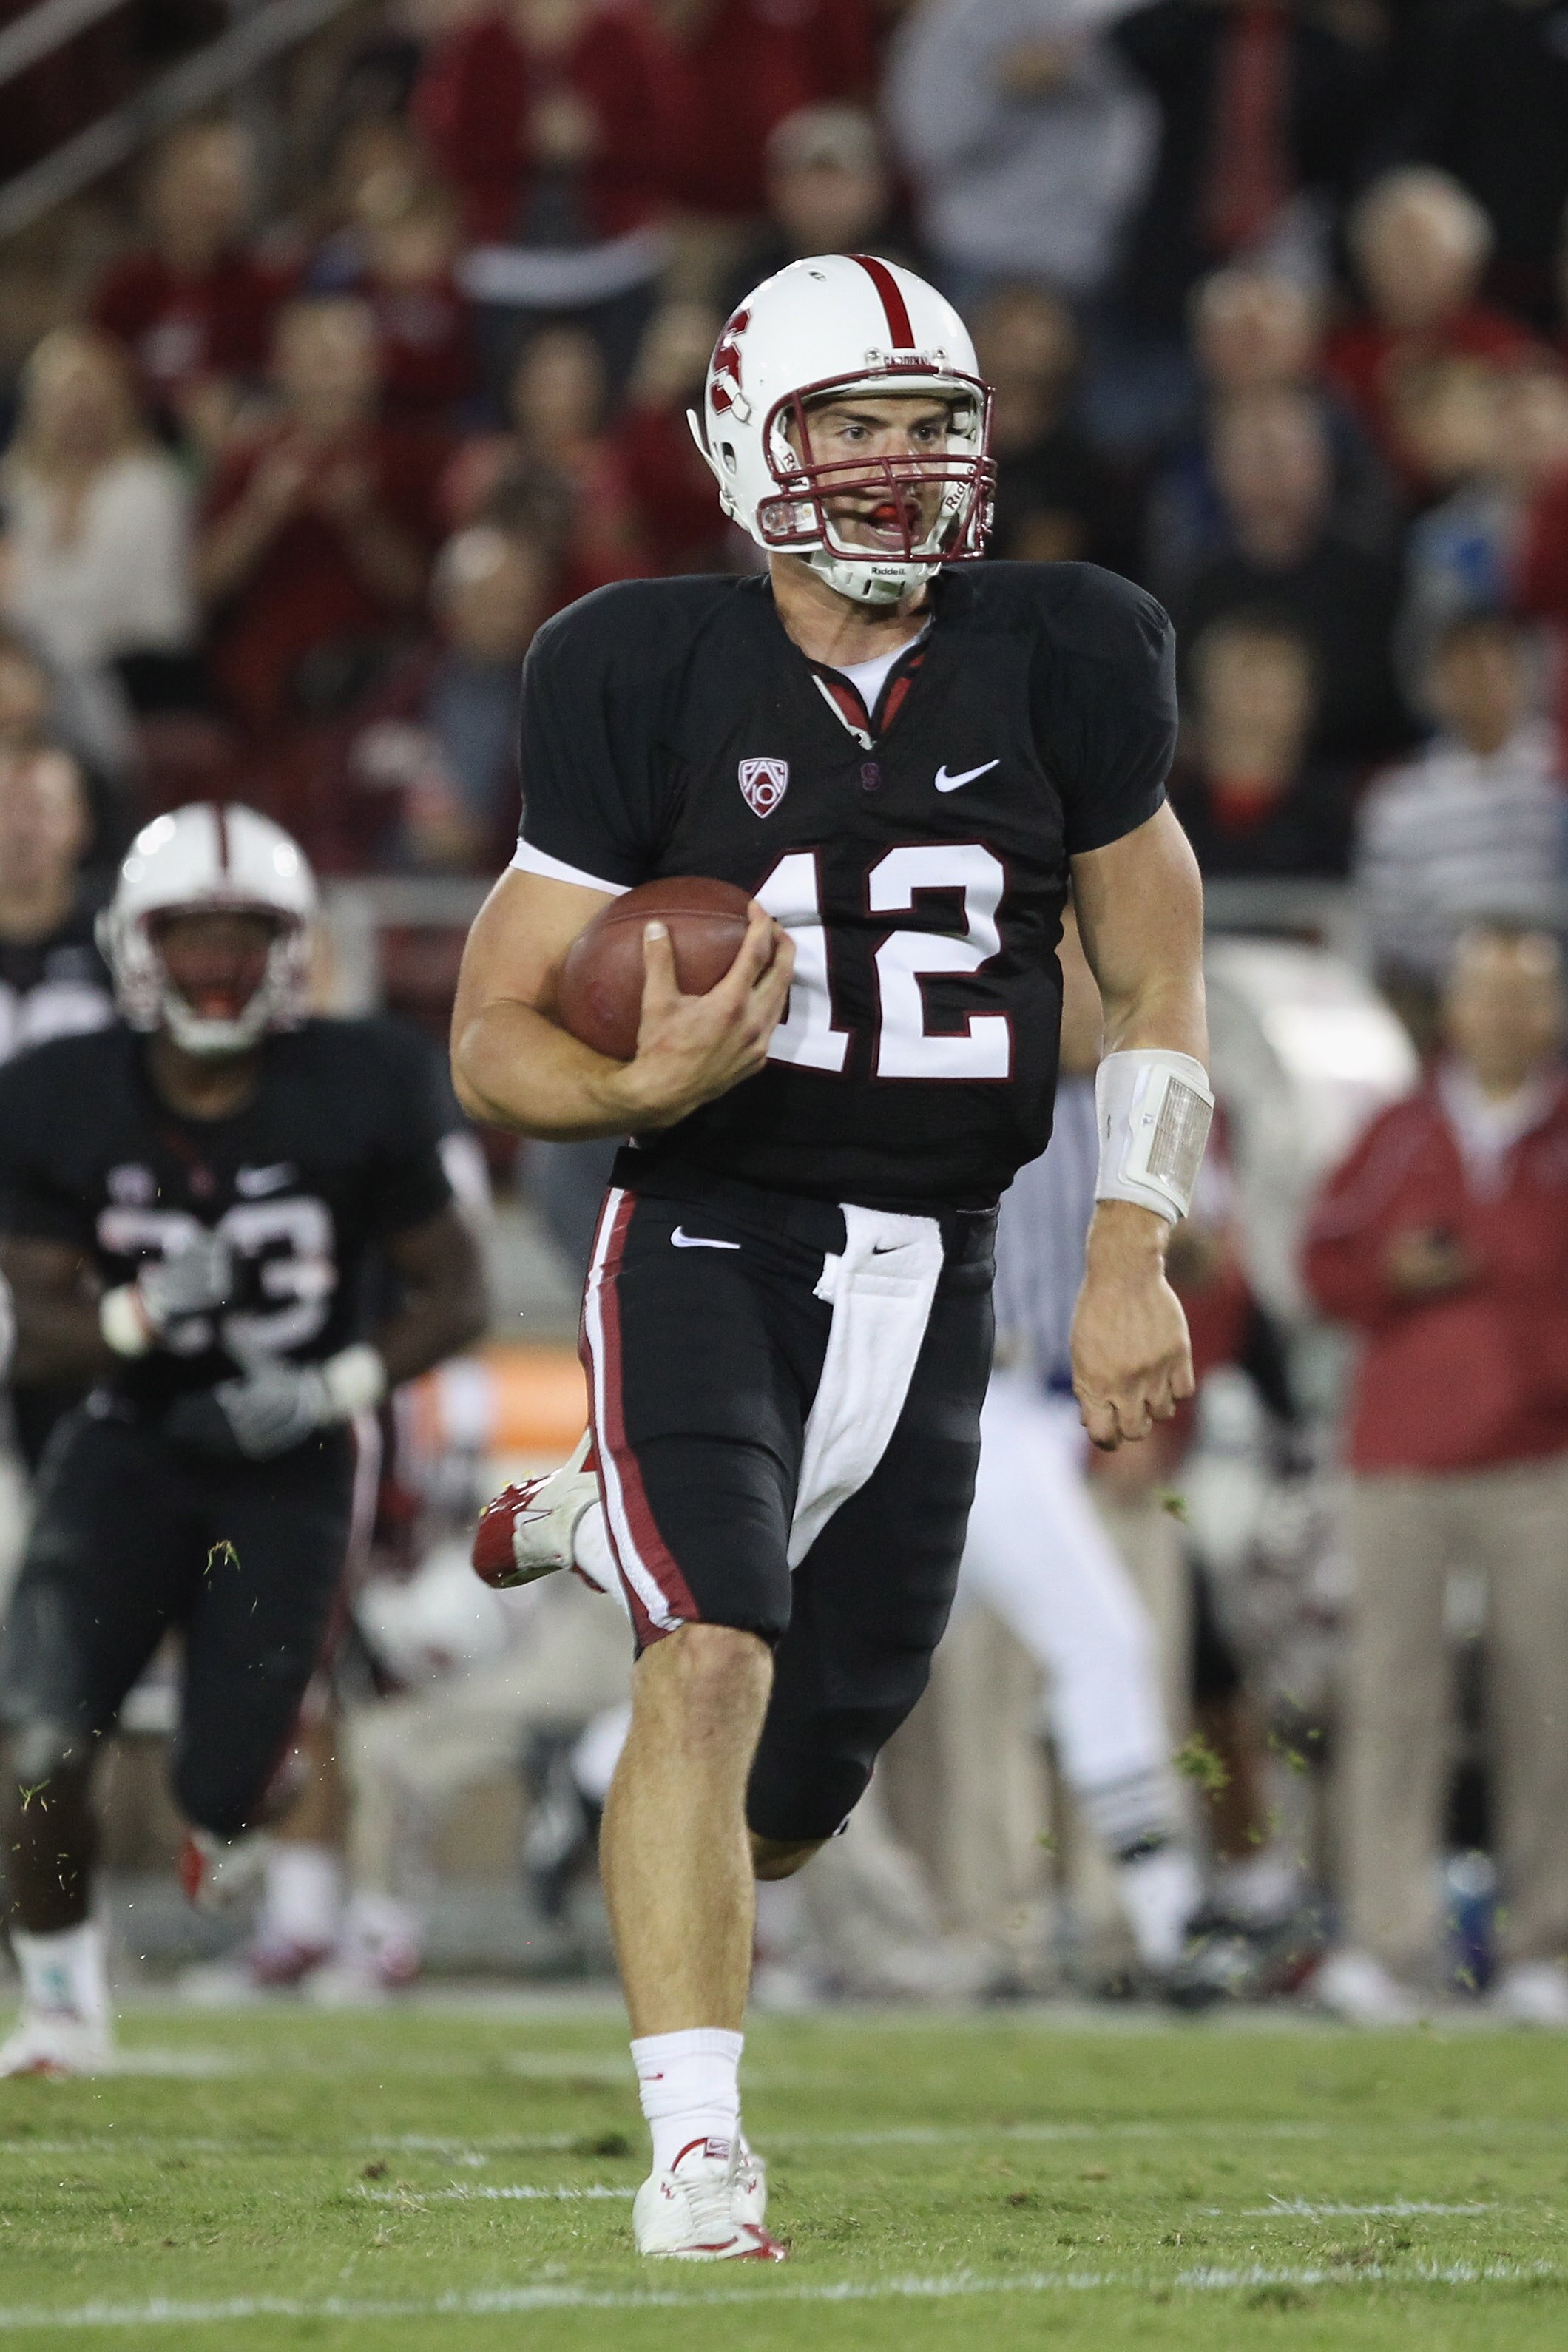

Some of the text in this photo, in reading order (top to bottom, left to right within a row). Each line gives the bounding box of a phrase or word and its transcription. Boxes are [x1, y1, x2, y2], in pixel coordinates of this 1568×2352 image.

[871, 567, 907, 575] Riddell
[751, 783, 777, 805] 10
[751, 842, 1011, 1080] 12
